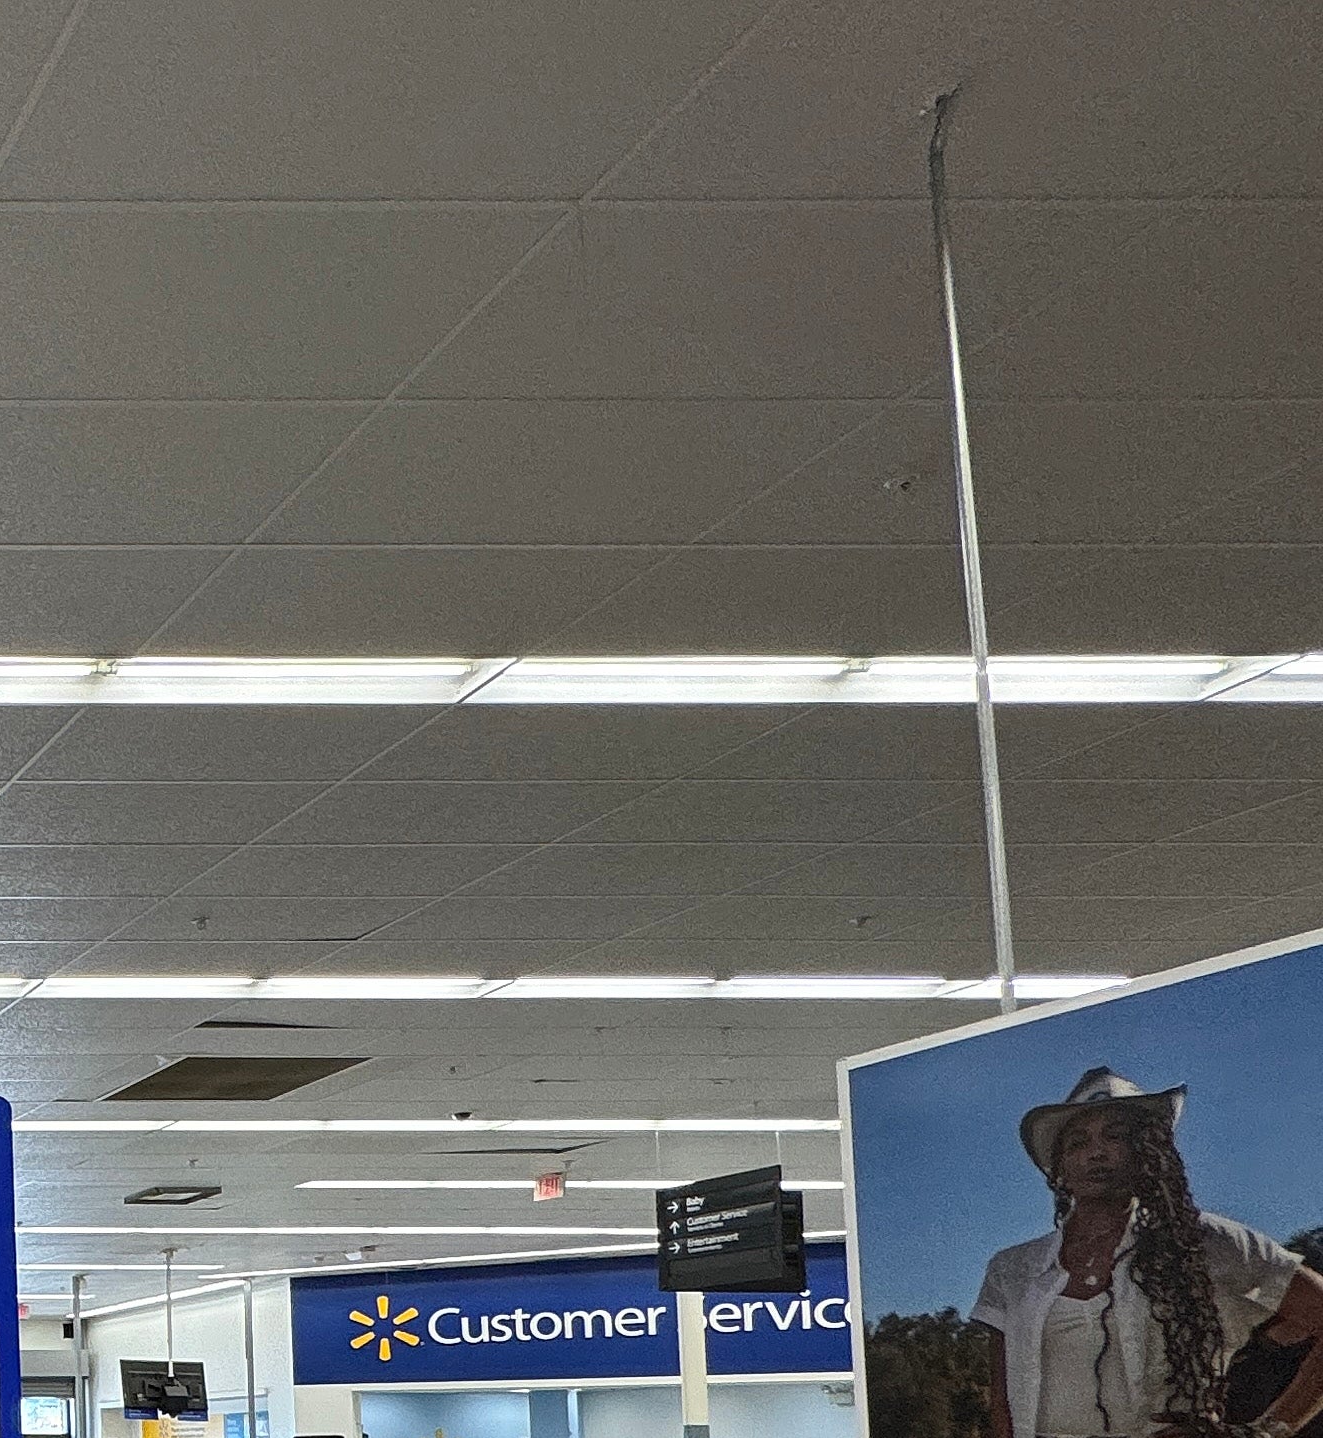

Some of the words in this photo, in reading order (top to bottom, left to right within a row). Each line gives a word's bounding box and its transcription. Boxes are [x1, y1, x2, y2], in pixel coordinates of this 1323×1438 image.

[686, 1197, 705, 1206] Baby
[687, 1214, 721, 1226] Customer
[427, 1306, 667, 1346] Customer
[700, 1290, 855, 1332] ervic
